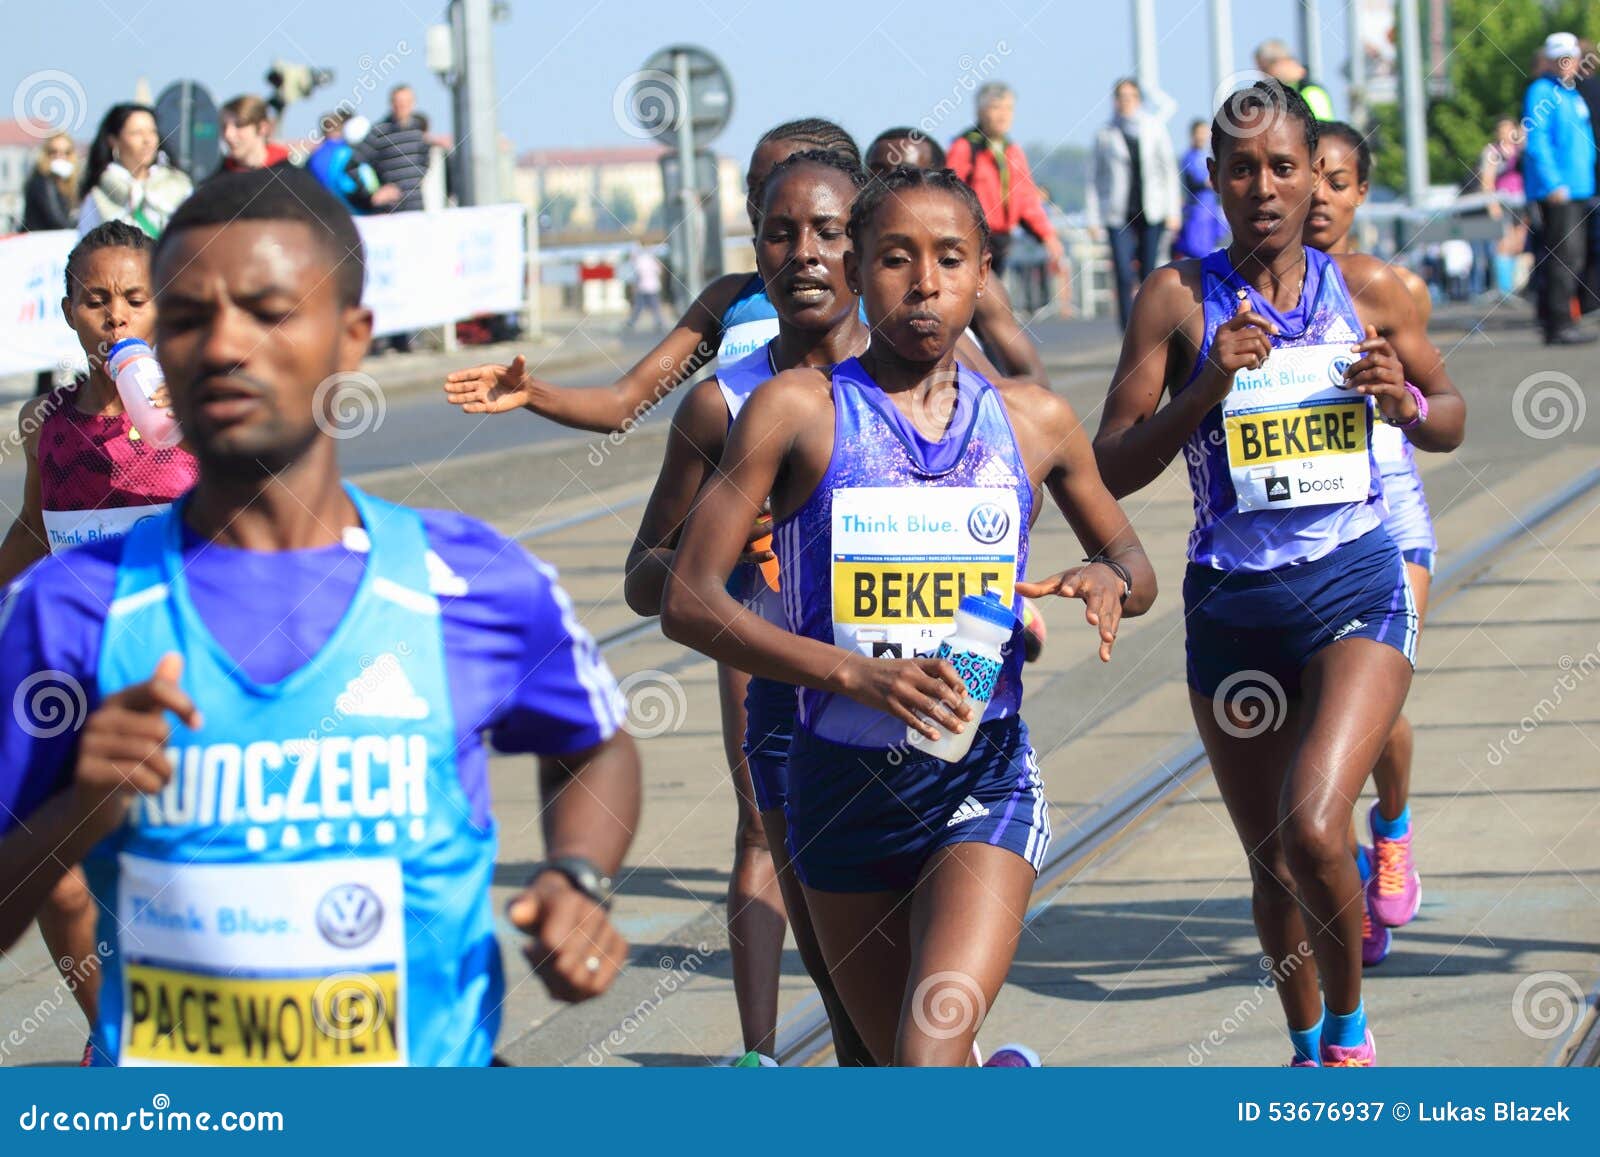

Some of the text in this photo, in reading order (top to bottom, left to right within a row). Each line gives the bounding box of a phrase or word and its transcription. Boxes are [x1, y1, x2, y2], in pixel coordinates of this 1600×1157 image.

[1236, 374, 1272, 391] hink
[1240, 411, 1356, 460] BEKERE
[1302, 461, 1313, 470] F3
[1298, 476, 1345, 493] boost
[842, 514, 959, 533] Think Blue.
[50, 529, 83, 545] Think
[921, 629, 933, 638] F1
[131, 894, 206, 932] Think
[128, 979, 398, 1063] PACE WOMEN
